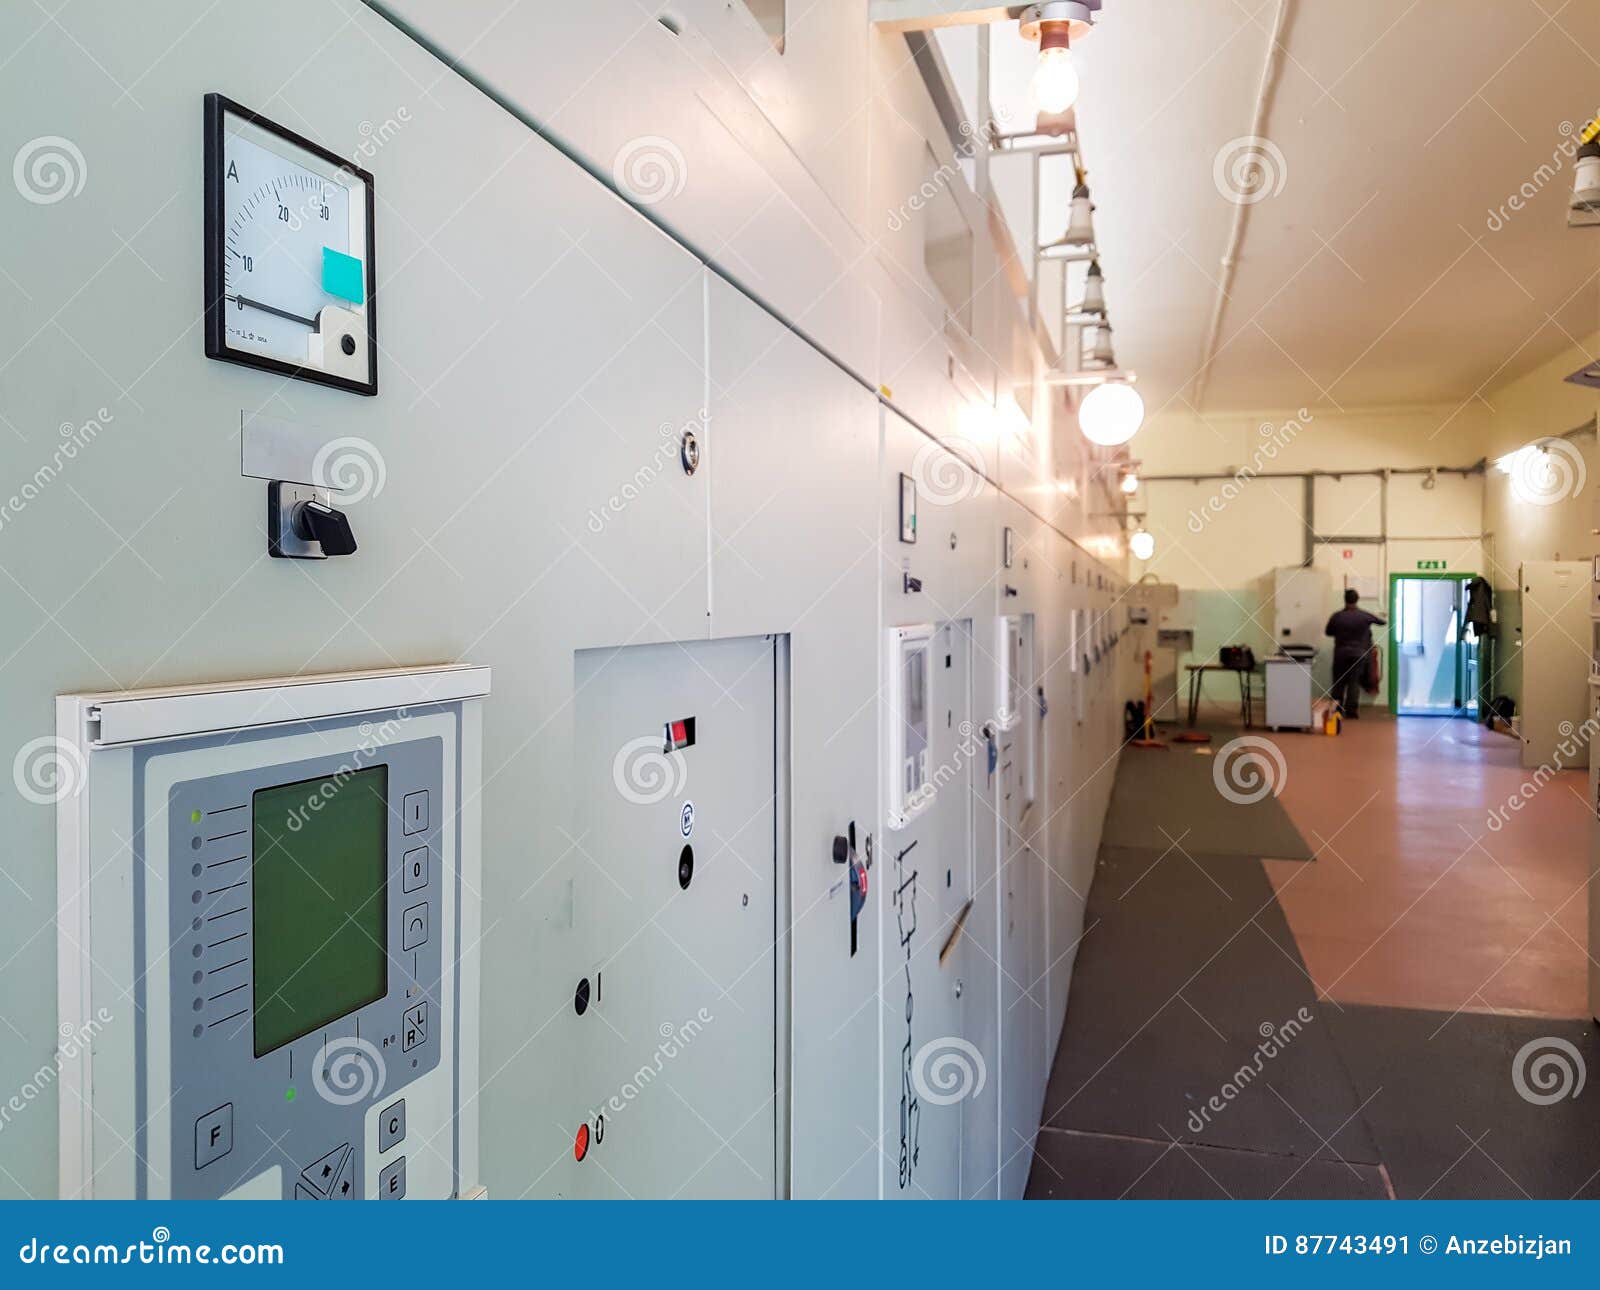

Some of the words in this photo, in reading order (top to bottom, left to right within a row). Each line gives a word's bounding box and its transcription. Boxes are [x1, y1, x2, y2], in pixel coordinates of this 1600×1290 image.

[227, 160, 239, 183] A
[278, 204, 289, 222] 20
[319, 203, 329, 221] 30
[242, 255, 253, 273] 10
[406, 988, 411, 999] L
[417, 1010, 425, 1024] L
[382, 1038, 389, 1048] R
[407, 1029, 416, 1046] R
[389, 1117, 398, 1135] C
[211, 1125, 221, 1147] F
[389, 1174, 398, 1194] E
